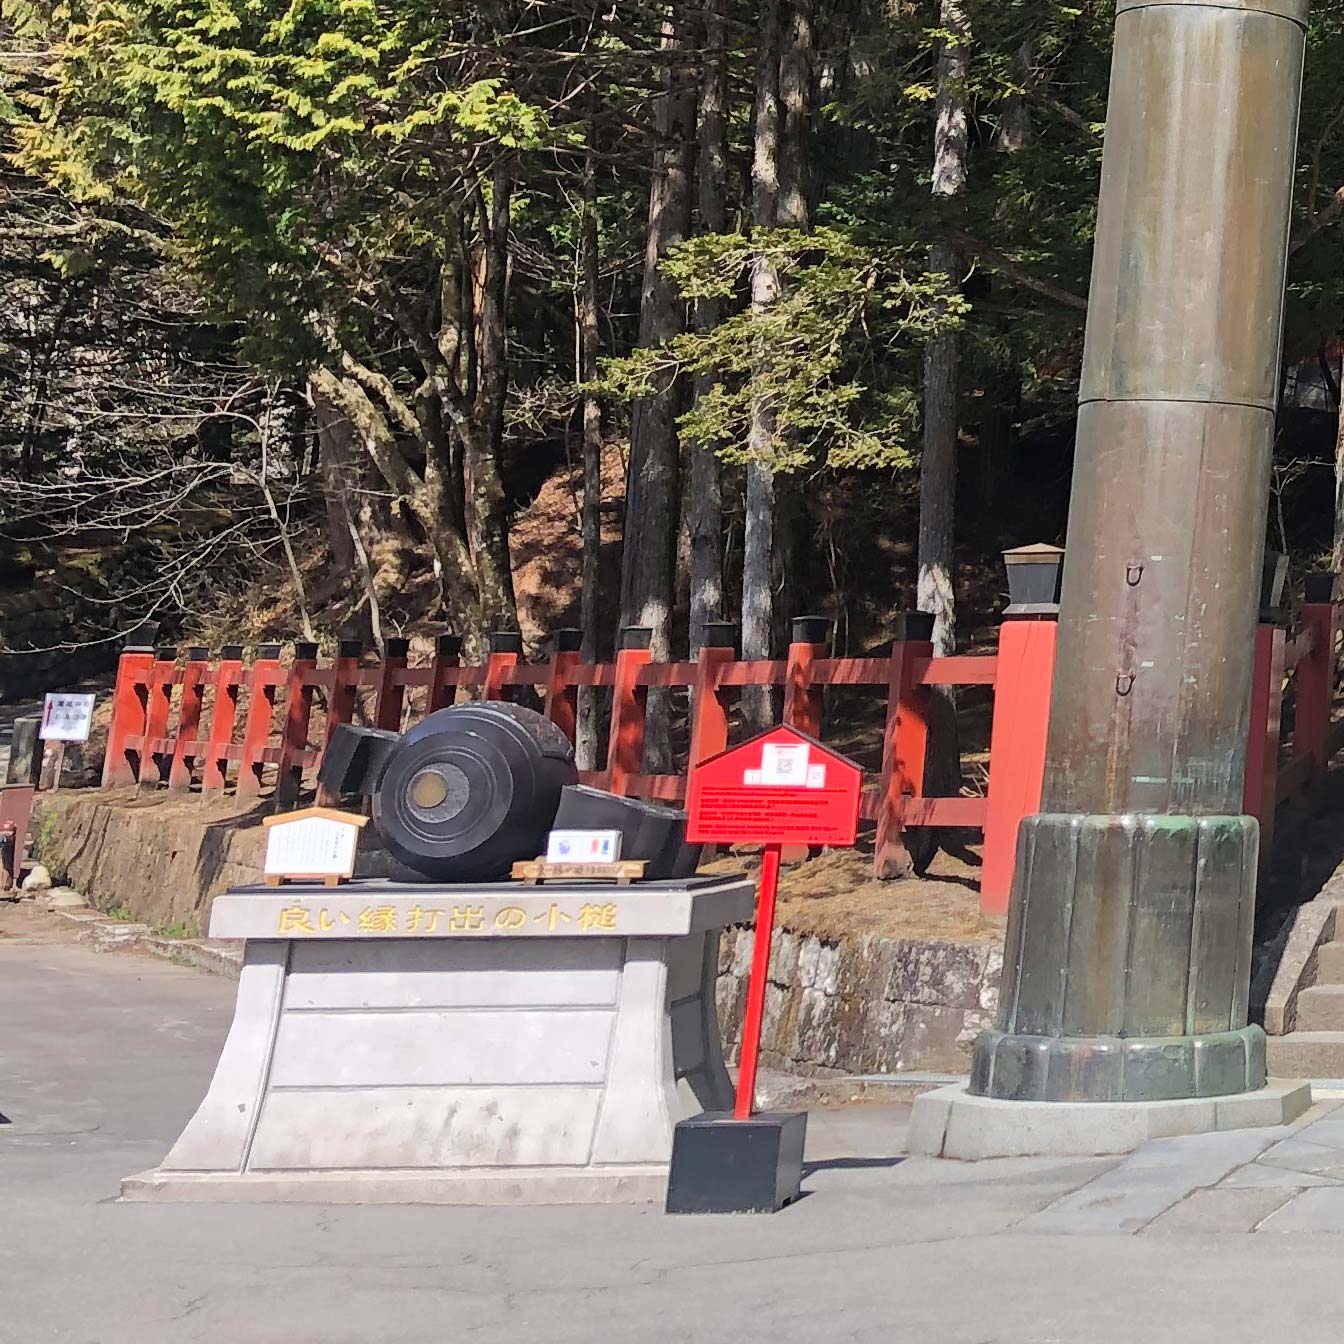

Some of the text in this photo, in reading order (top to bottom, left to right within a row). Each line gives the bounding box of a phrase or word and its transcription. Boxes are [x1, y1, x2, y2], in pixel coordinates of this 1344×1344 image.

[277, 901, 618, 935] 良い縁打出の小槌
